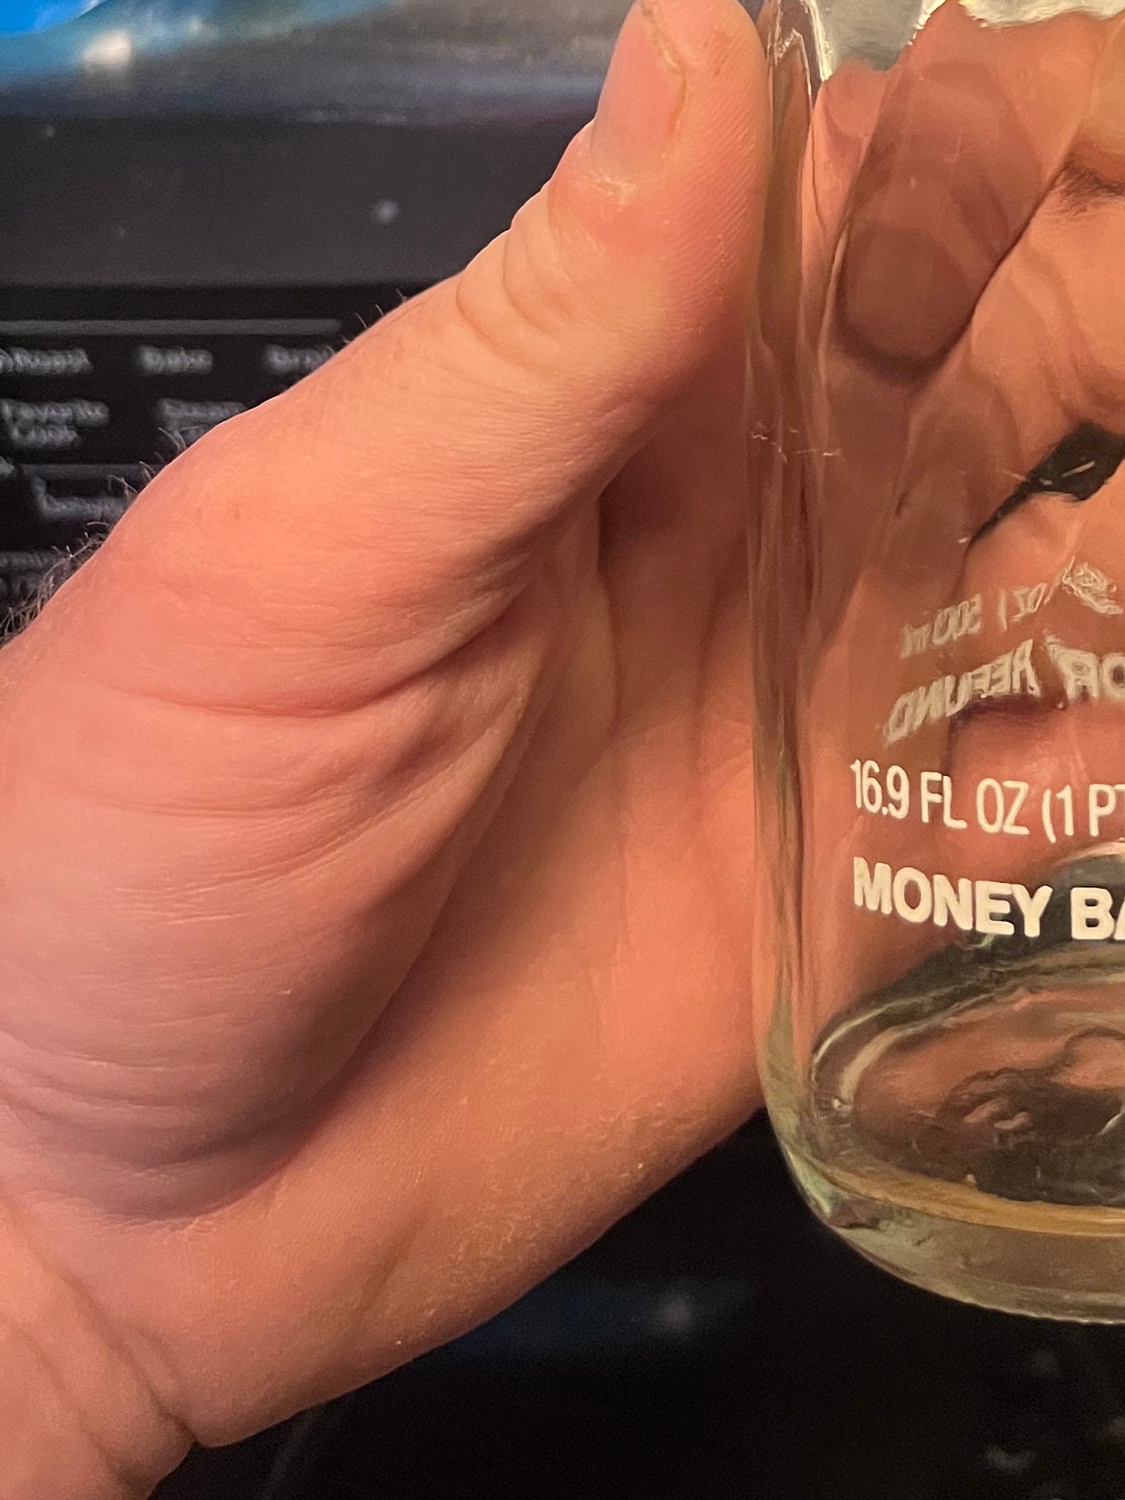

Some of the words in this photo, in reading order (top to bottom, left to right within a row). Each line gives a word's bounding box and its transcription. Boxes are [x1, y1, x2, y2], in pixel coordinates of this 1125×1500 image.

[850, 759, 909, 819] 16.9
[920, 771, 968, 829] FL
[976, 777, 1030, 835] OZ
[853, 856, 1053, 938] MONEY
